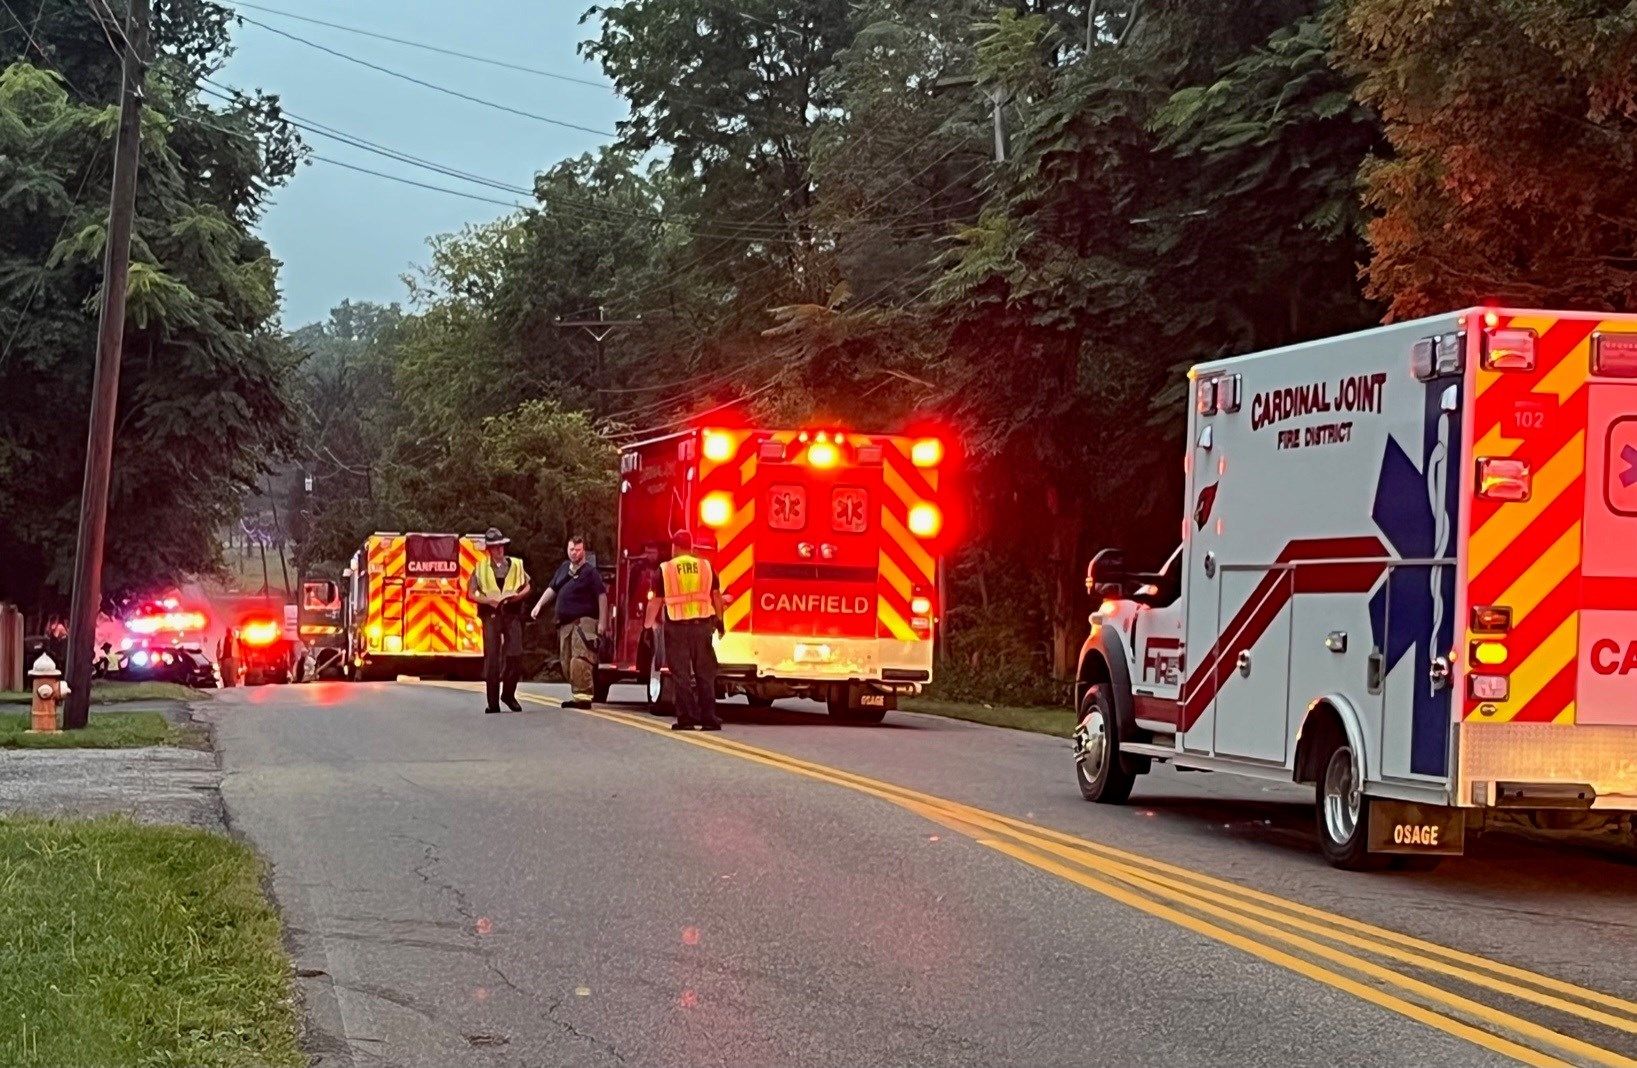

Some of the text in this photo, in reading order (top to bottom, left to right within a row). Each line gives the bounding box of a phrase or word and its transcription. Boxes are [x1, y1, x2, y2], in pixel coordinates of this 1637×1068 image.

[1251, 372, 1387, 431] CARDINAL JOINT
[1514, 411, 1544, 428] 102
[1277, 421, 1353, 450] FIRE DISTRICT
[407, 560, 457, 572] CANFIELD
[676, 561, 699, 576] FIRE
[760, 592, 869, 615] CANFIELD
[1393, 824, 1438, 845] OSAGE
